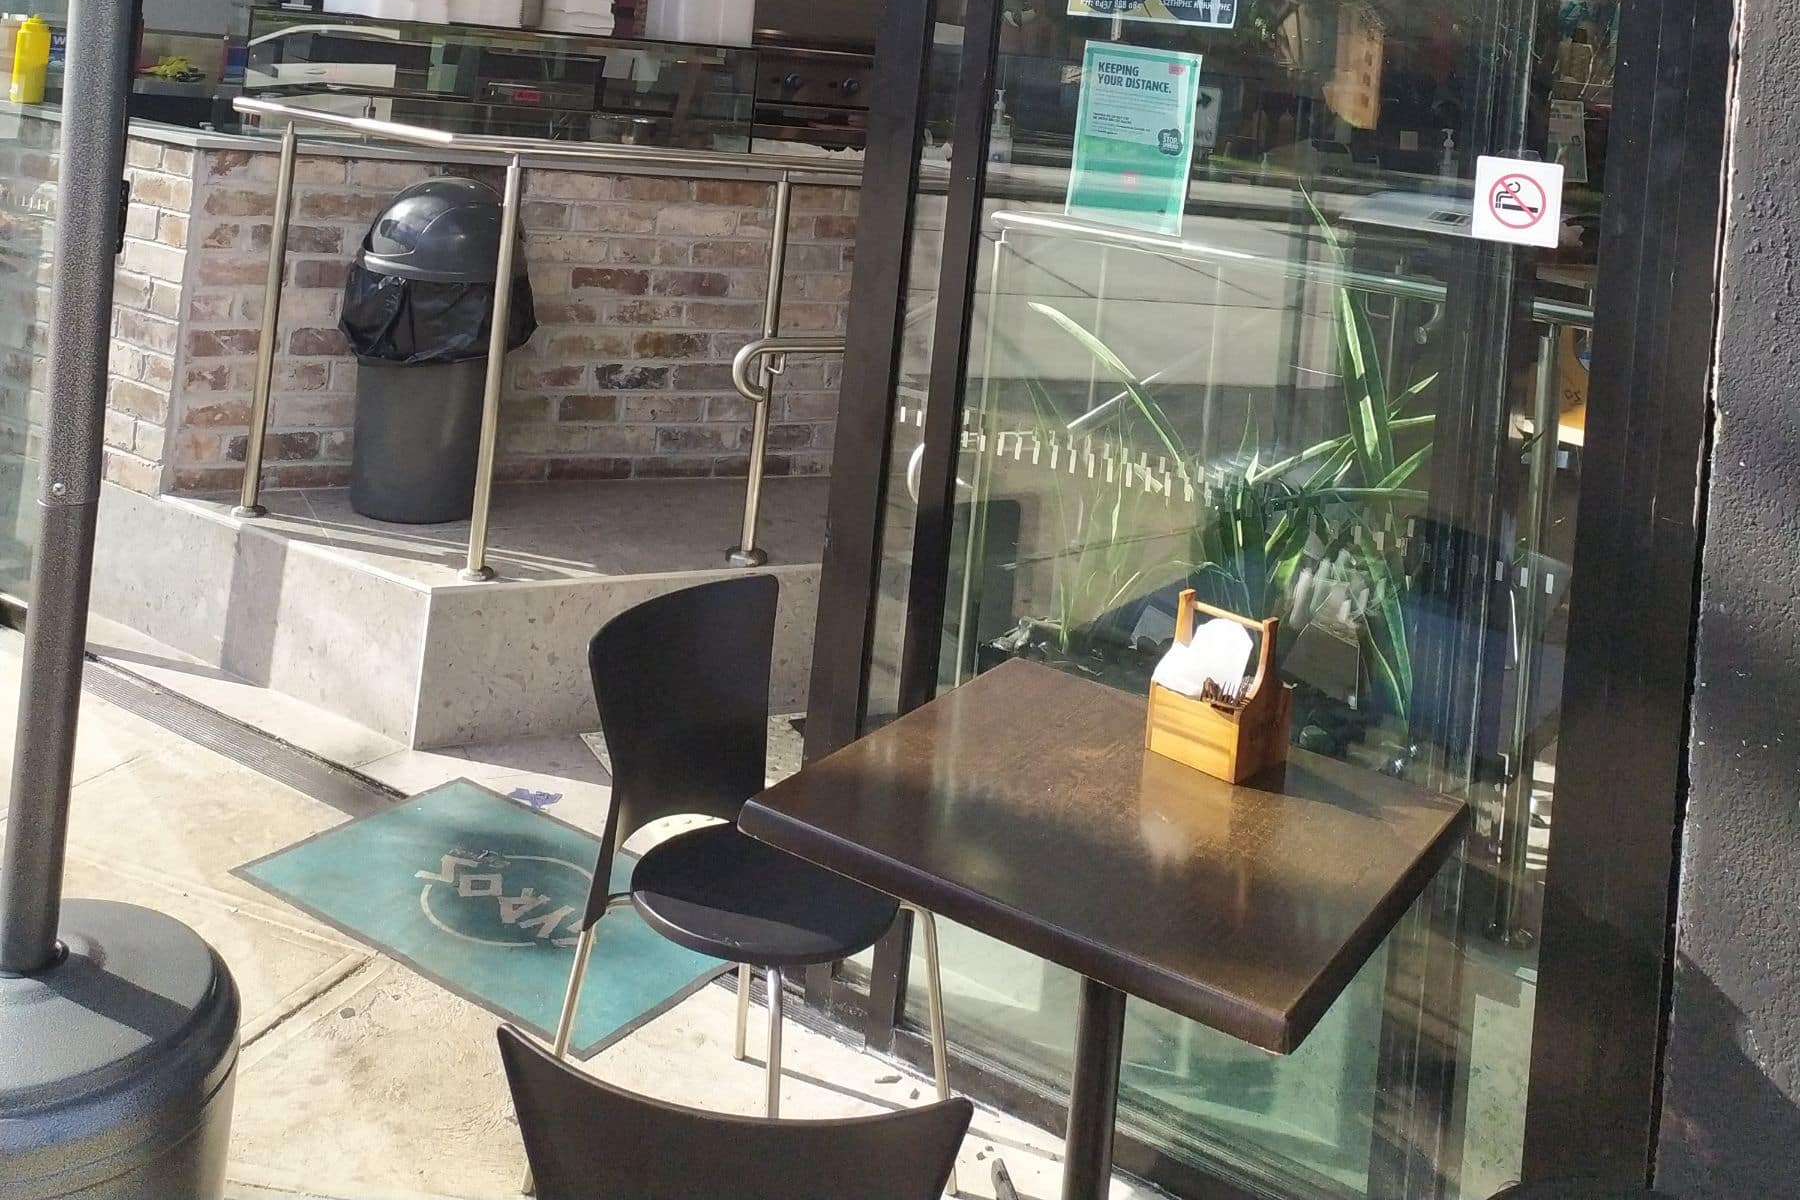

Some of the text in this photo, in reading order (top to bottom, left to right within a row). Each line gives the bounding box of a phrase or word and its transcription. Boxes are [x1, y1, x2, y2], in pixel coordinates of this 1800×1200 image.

[1098, 61, 1139, 77] KEEPING
[1098, 74, 1172, 94] YOUR DISTANCE.
